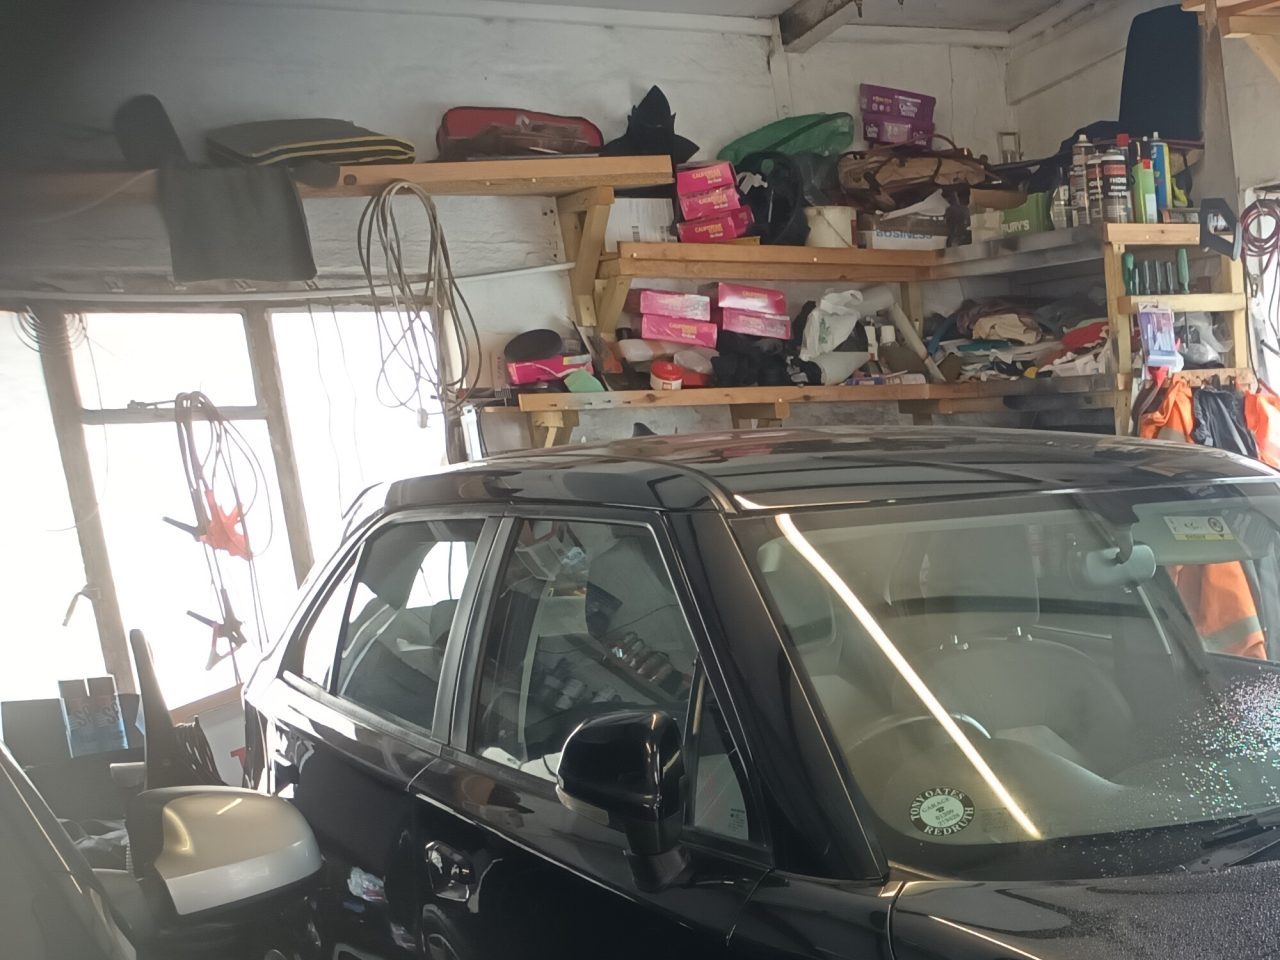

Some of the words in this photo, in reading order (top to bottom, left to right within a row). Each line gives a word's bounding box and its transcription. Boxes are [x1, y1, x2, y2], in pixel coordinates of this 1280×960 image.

[910, 795, 924, 821] TONY
[925, 788, 965, 800] OATES
[924, 807, 974, 835] REDRUTH
